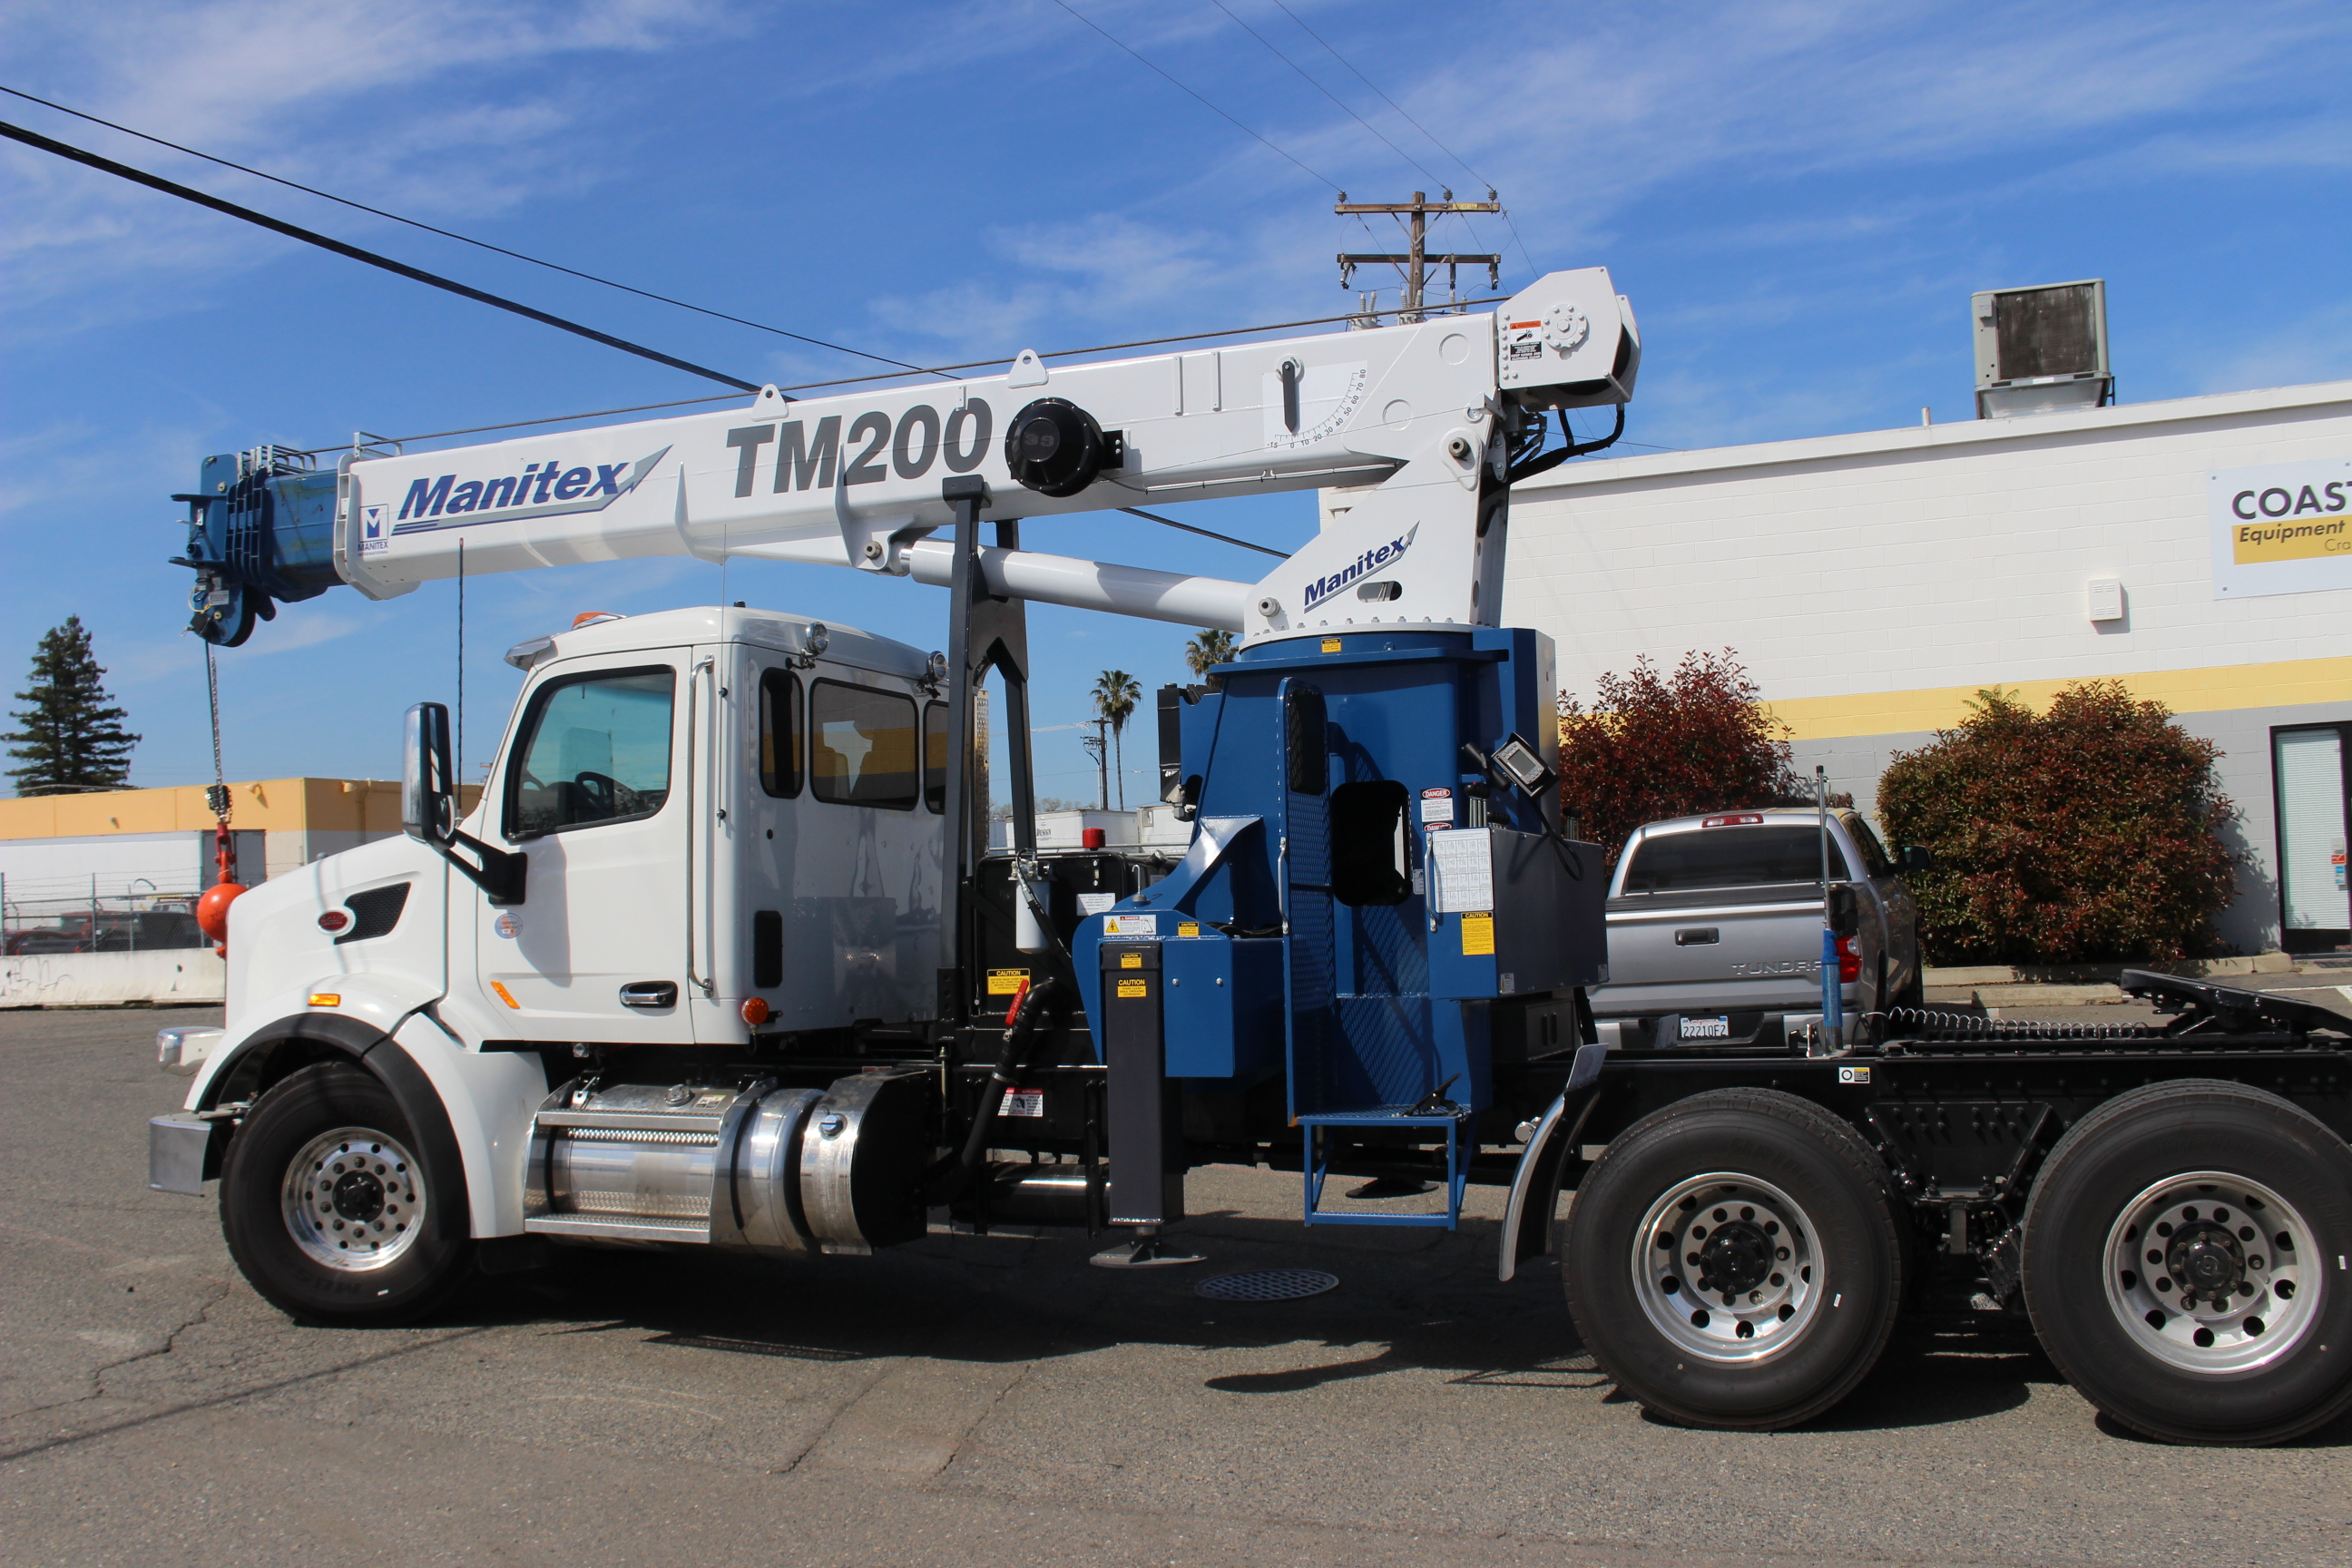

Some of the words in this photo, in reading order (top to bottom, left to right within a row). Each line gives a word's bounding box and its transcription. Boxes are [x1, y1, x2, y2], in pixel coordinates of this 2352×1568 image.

[1359, 368, 1367, 378] 80
[1356, 382, 1364, 392] 70
[1350, 395, 1359, 405] 60
[1343, 407, 1352, 416] 50
[1335, 417, 1344, 427] 40
[1325, 426, 1334, 436] 30
[1300, 438, 1309, 446] 10
[1313, 433, 1322, 442] 20
[727, 397, 993, 498] TM200
[397, 461, 630, 520] Manitex
[2239, 519, 2347, 546] Equipment
[358, 541, 388, 551] MANITEX
[1305, 535, 1405, 606] Manitex
[1425, 789, 1447, 798] DANGER
[1683, 1024, 1726, 1037] 22210F2
